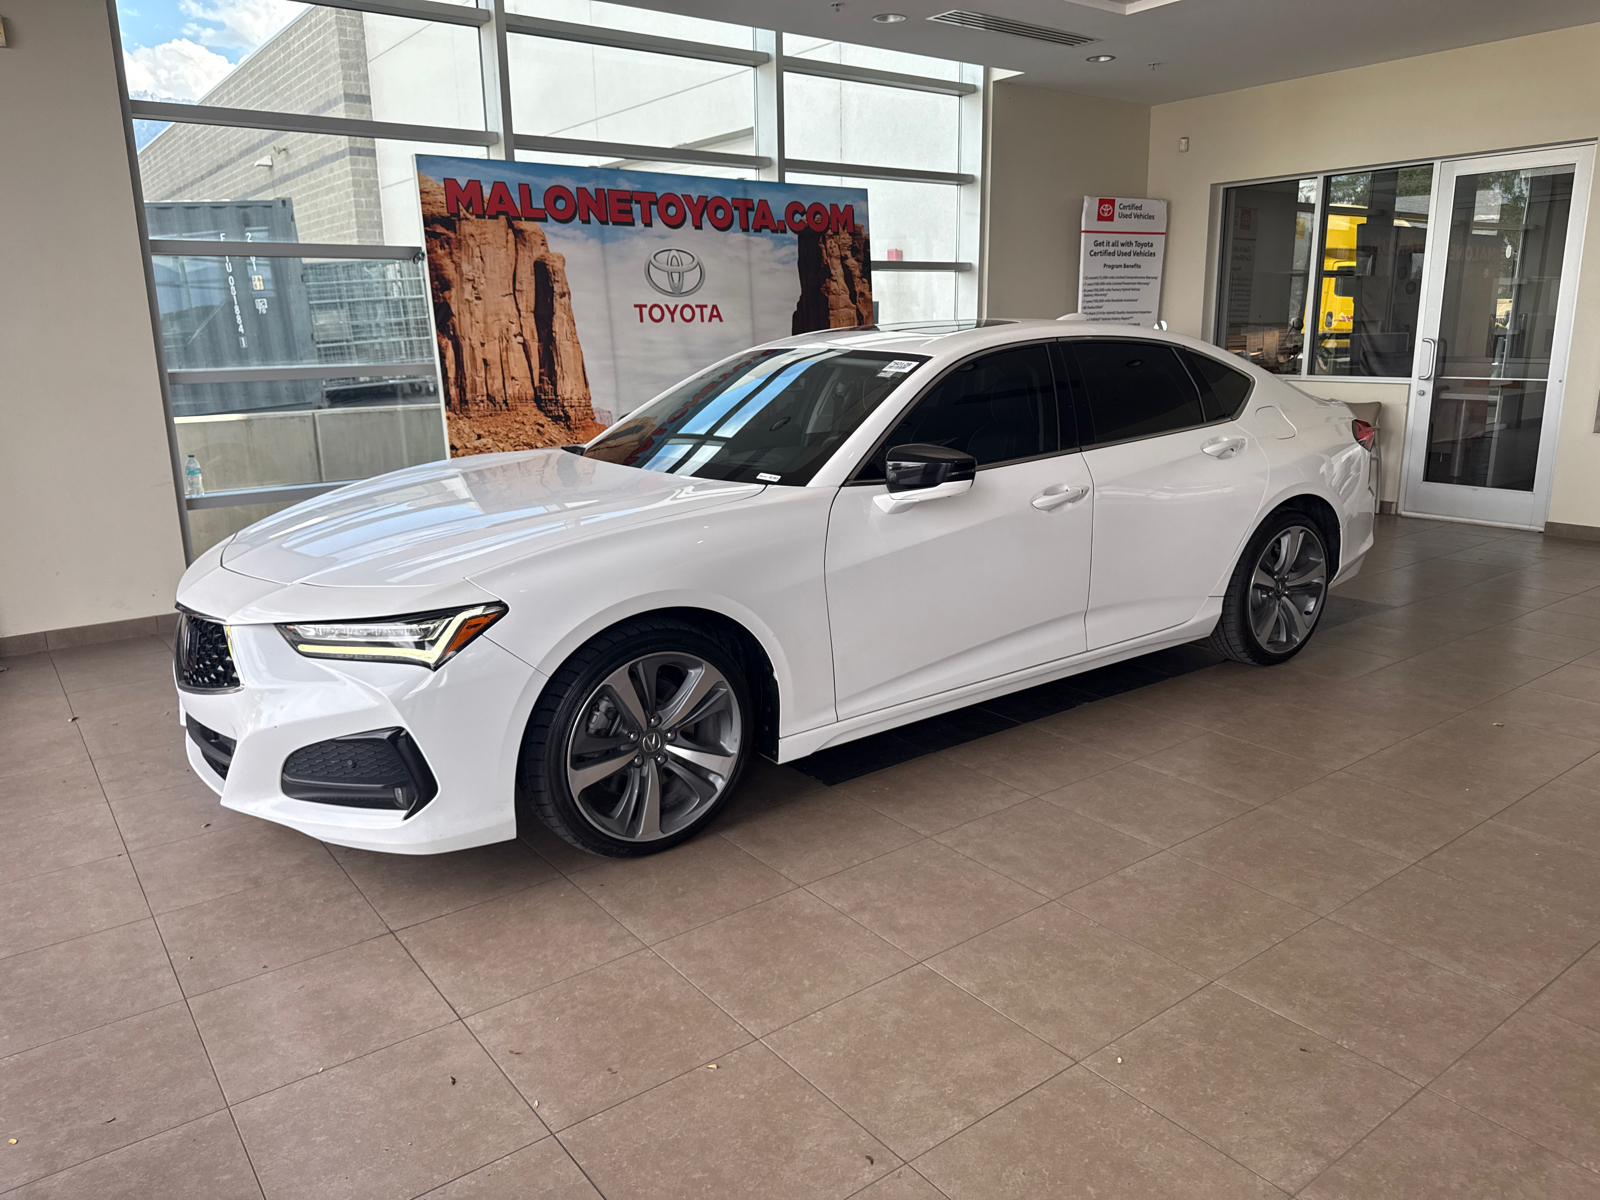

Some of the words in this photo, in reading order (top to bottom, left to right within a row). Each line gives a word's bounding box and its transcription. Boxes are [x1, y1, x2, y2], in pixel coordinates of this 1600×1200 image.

[443, 177, 855, 234] MALONETOYOTA.COM
[1118, 203, 1143, 211] Certified
[1093, 240, 1105, 248] Get
[1111, 240, 1119, 248] all
[1120, 240, 1134, 248] with
[1134, 240, 1154, 249] Toyota
[1089, 249, 1116, 257] Certified
[1132, 250, 1156, 258] Vehicles
[633, 303, 724, 323] TOYOTA
